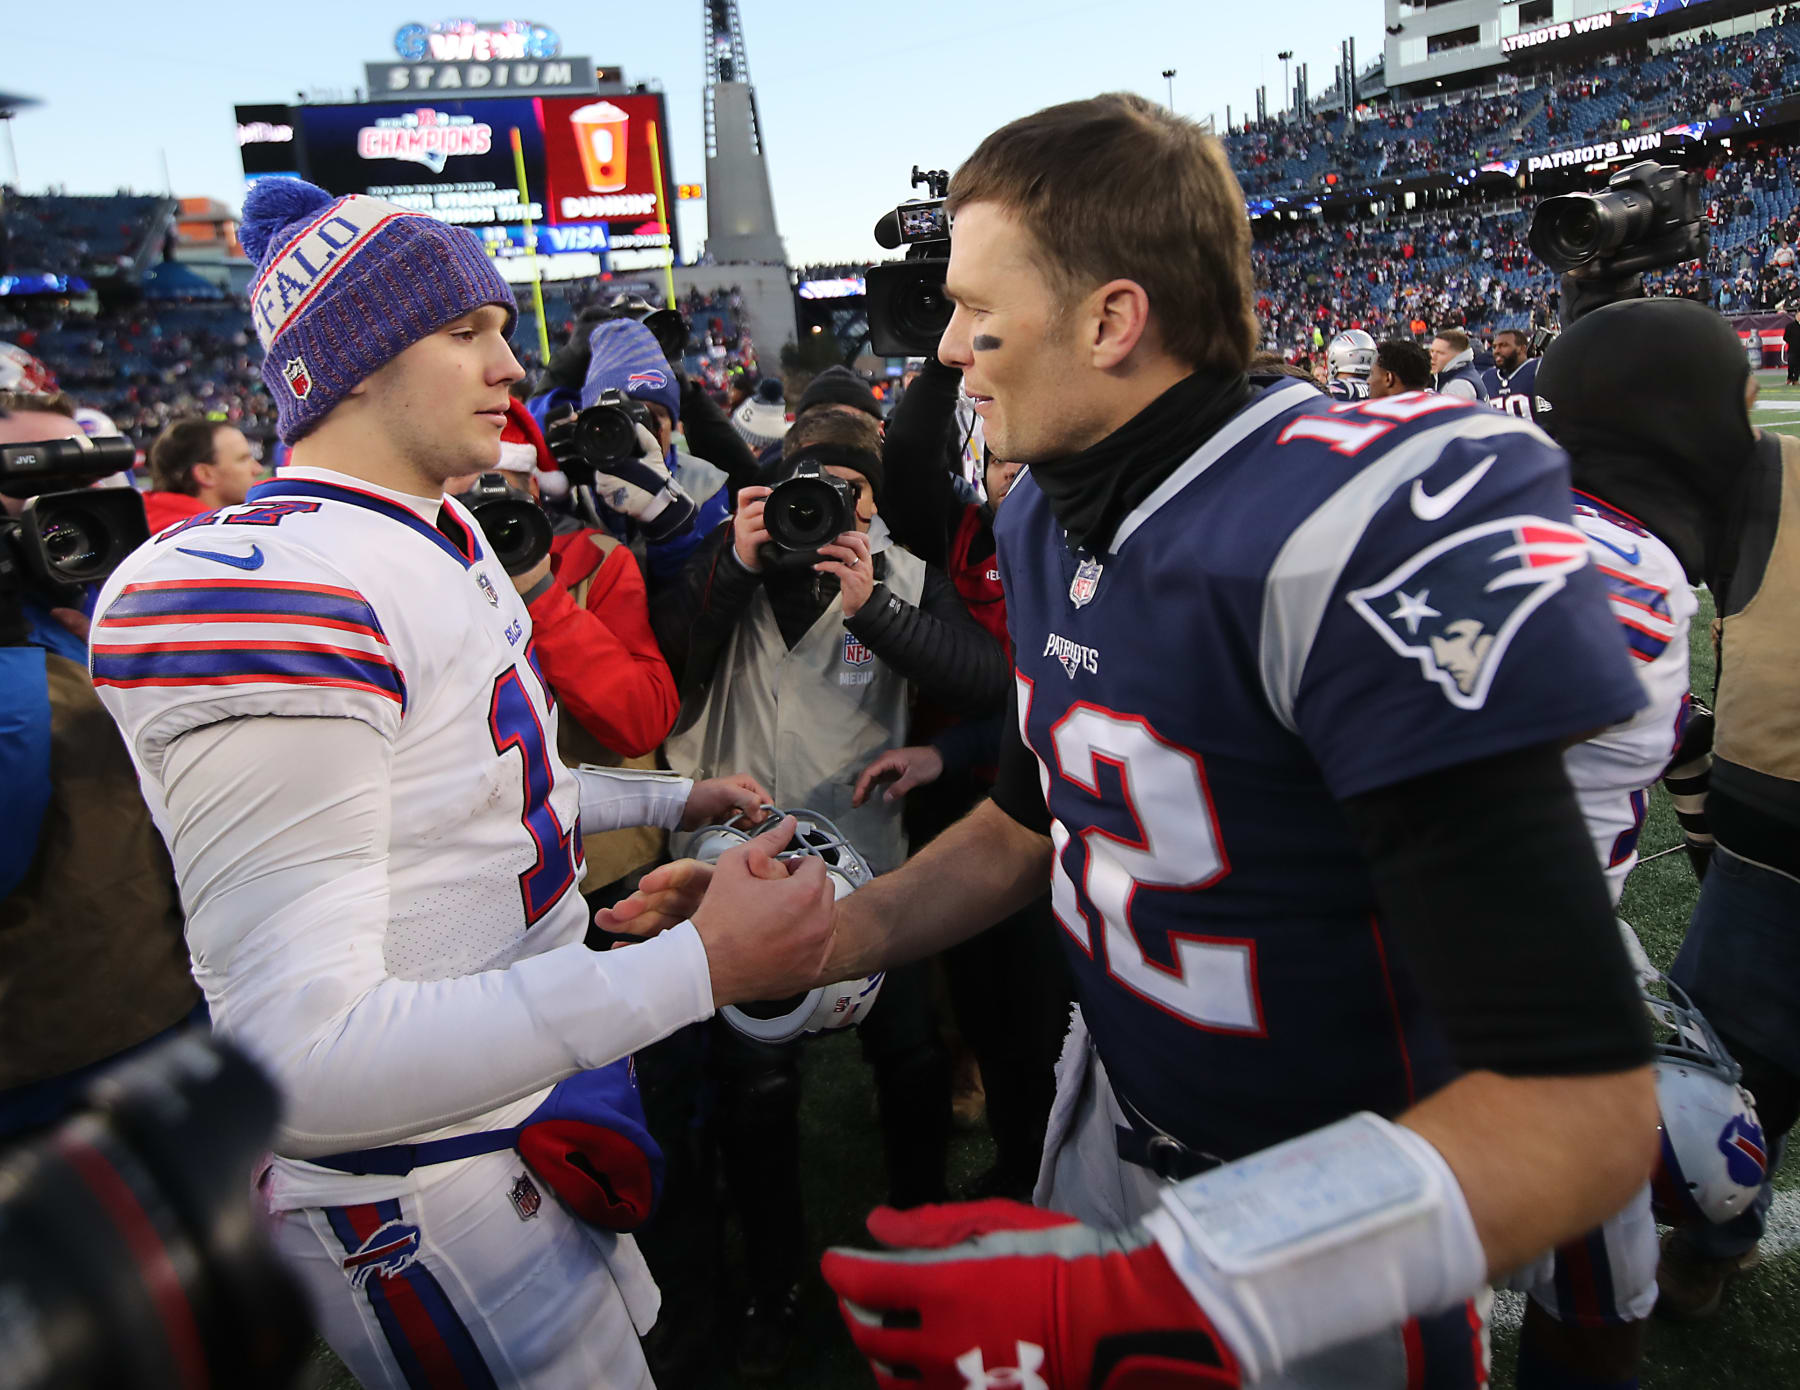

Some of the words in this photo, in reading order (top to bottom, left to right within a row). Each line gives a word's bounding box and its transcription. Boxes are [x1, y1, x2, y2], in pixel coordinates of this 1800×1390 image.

[1573, 12, 1612, 34] WIN
[388, 64, 572, 90] STADIUM
[362, 125, 492, 157] CHAMPIONS
[1528, 141, 1618, 172] PATRIOTS
[1621, 132, 1661, 153] WIN
[549, 226, 607, 250] VISA
[16, 455, 37, 465] JVC
[846, 644, 872, 663] NFL
[1043, 633, 1099, 675] PATRIOTS
